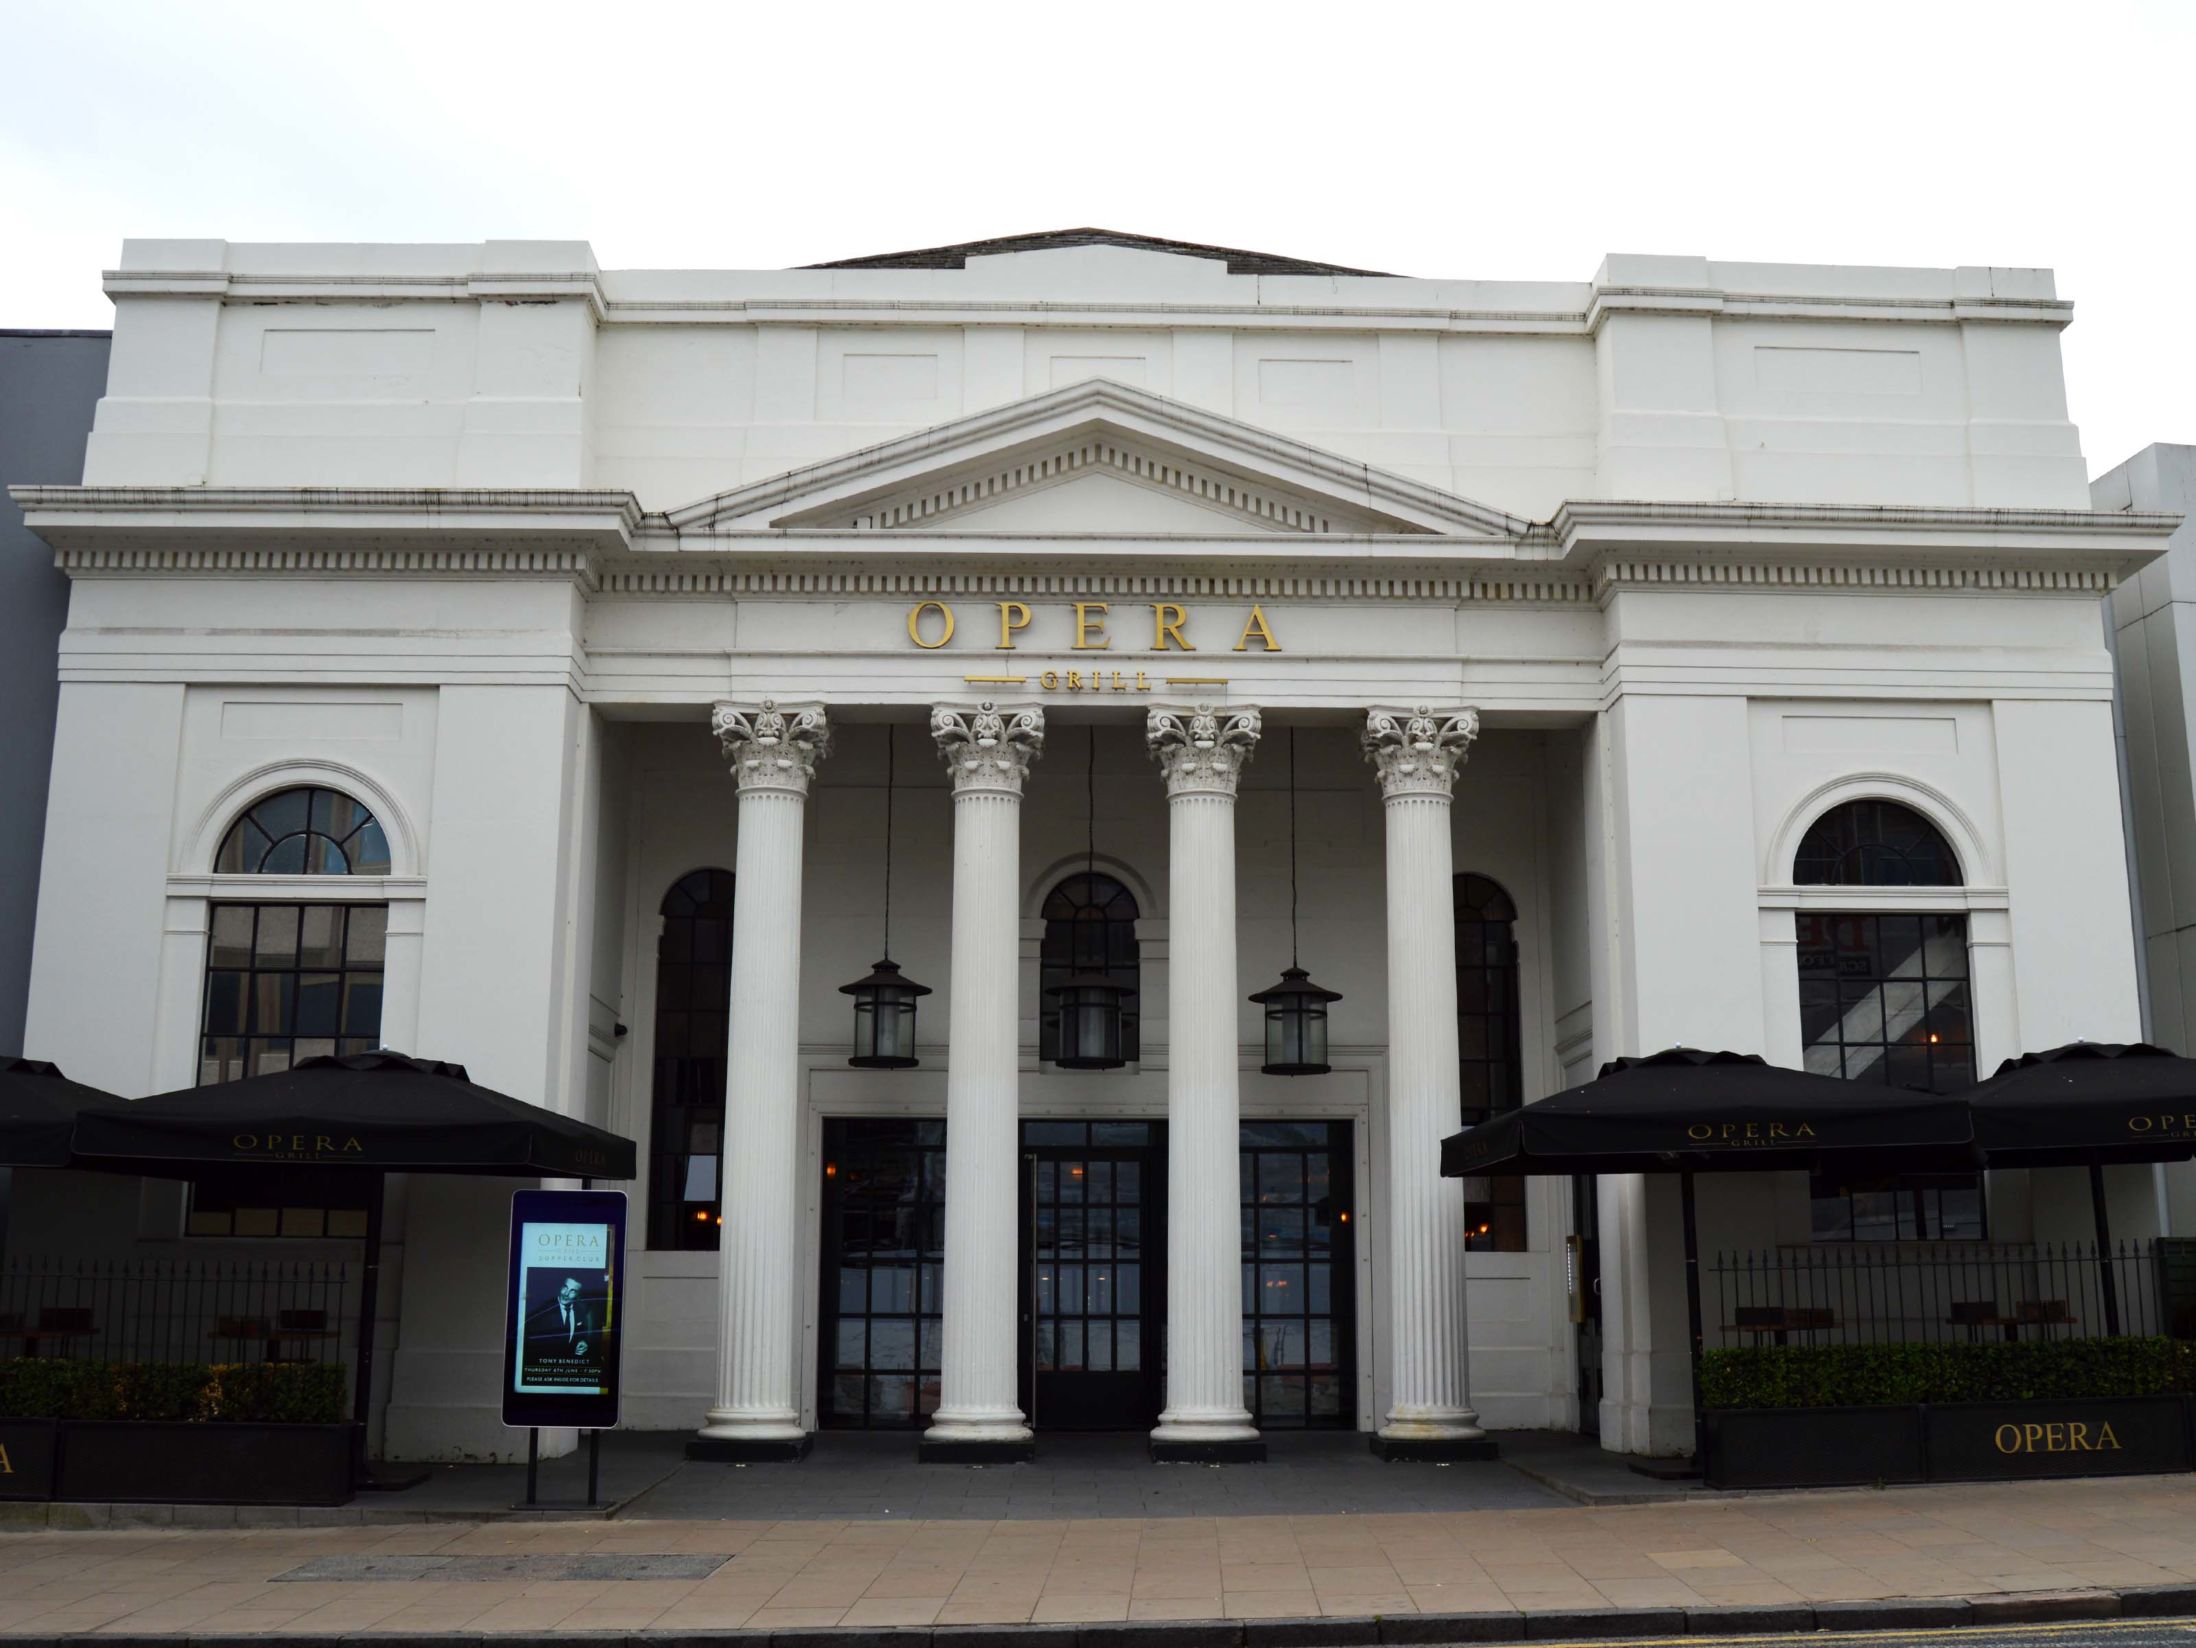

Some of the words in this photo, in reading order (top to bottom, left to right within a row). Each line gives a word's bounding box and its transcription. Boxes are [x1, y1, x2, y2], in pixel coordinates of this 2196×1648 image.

[907, 600, 1282, 652] OPERA
[1040, 670, 1152, 690] GRILL
[1687, 1121, 1817, 1139] OPERA
[232, 1134, 363, 1152] OPERA
[538, 1233, 599, 1247] OPERA
[1995, 1421, 2123, 1454] OPERA
